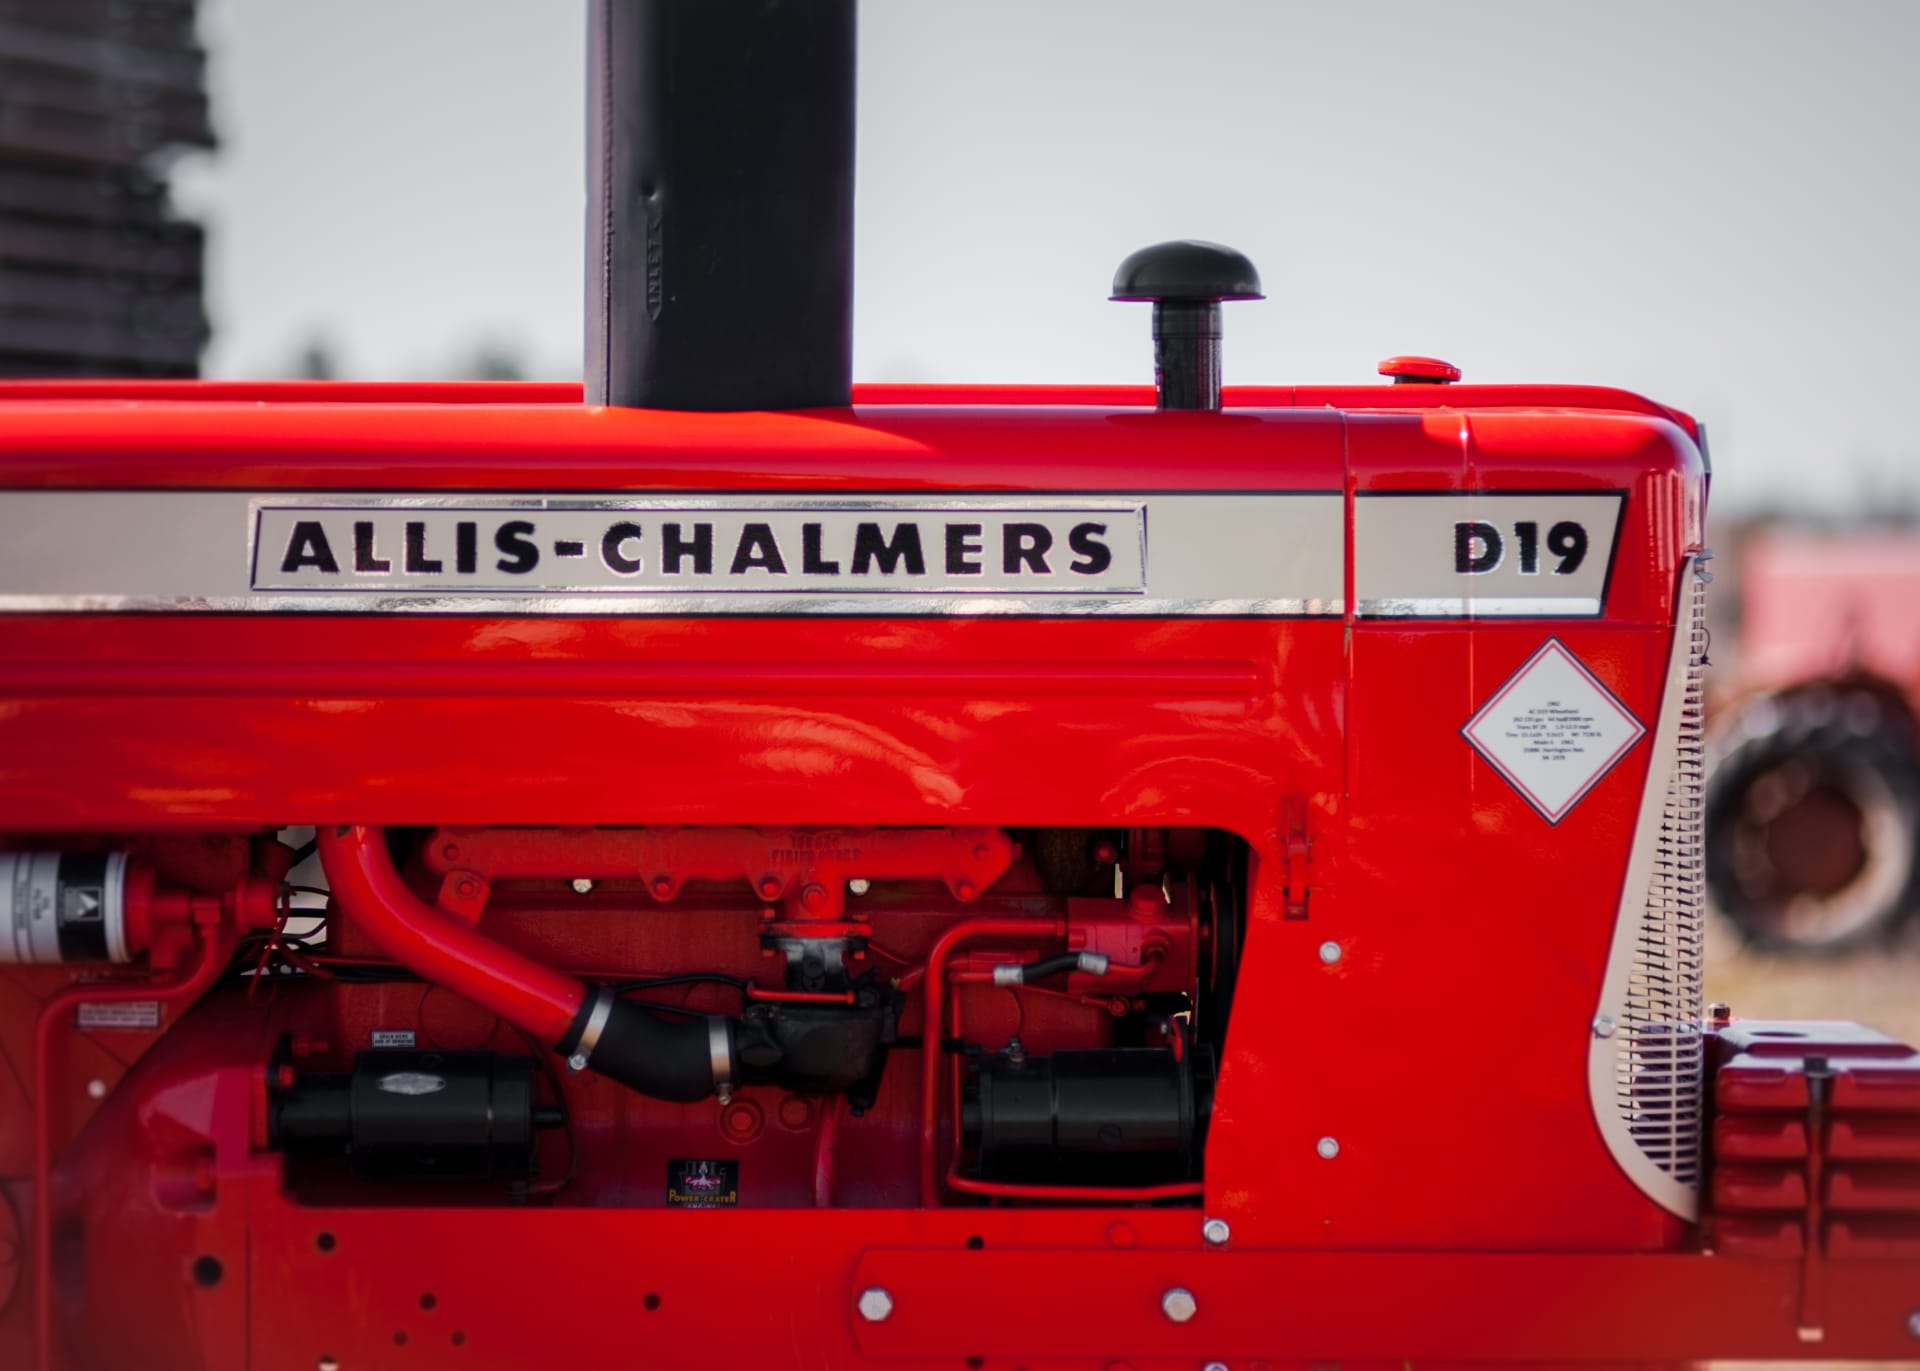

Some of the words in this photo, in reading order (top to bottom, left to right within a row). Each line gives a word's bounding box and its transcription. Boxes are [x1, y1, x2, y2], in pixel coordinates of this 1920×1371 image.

[648, 239, 660, 304] INLET
[281, 520, 1113, 576] ALLIS-CHALMERS
[1454, 520, 1589, 575] D19
